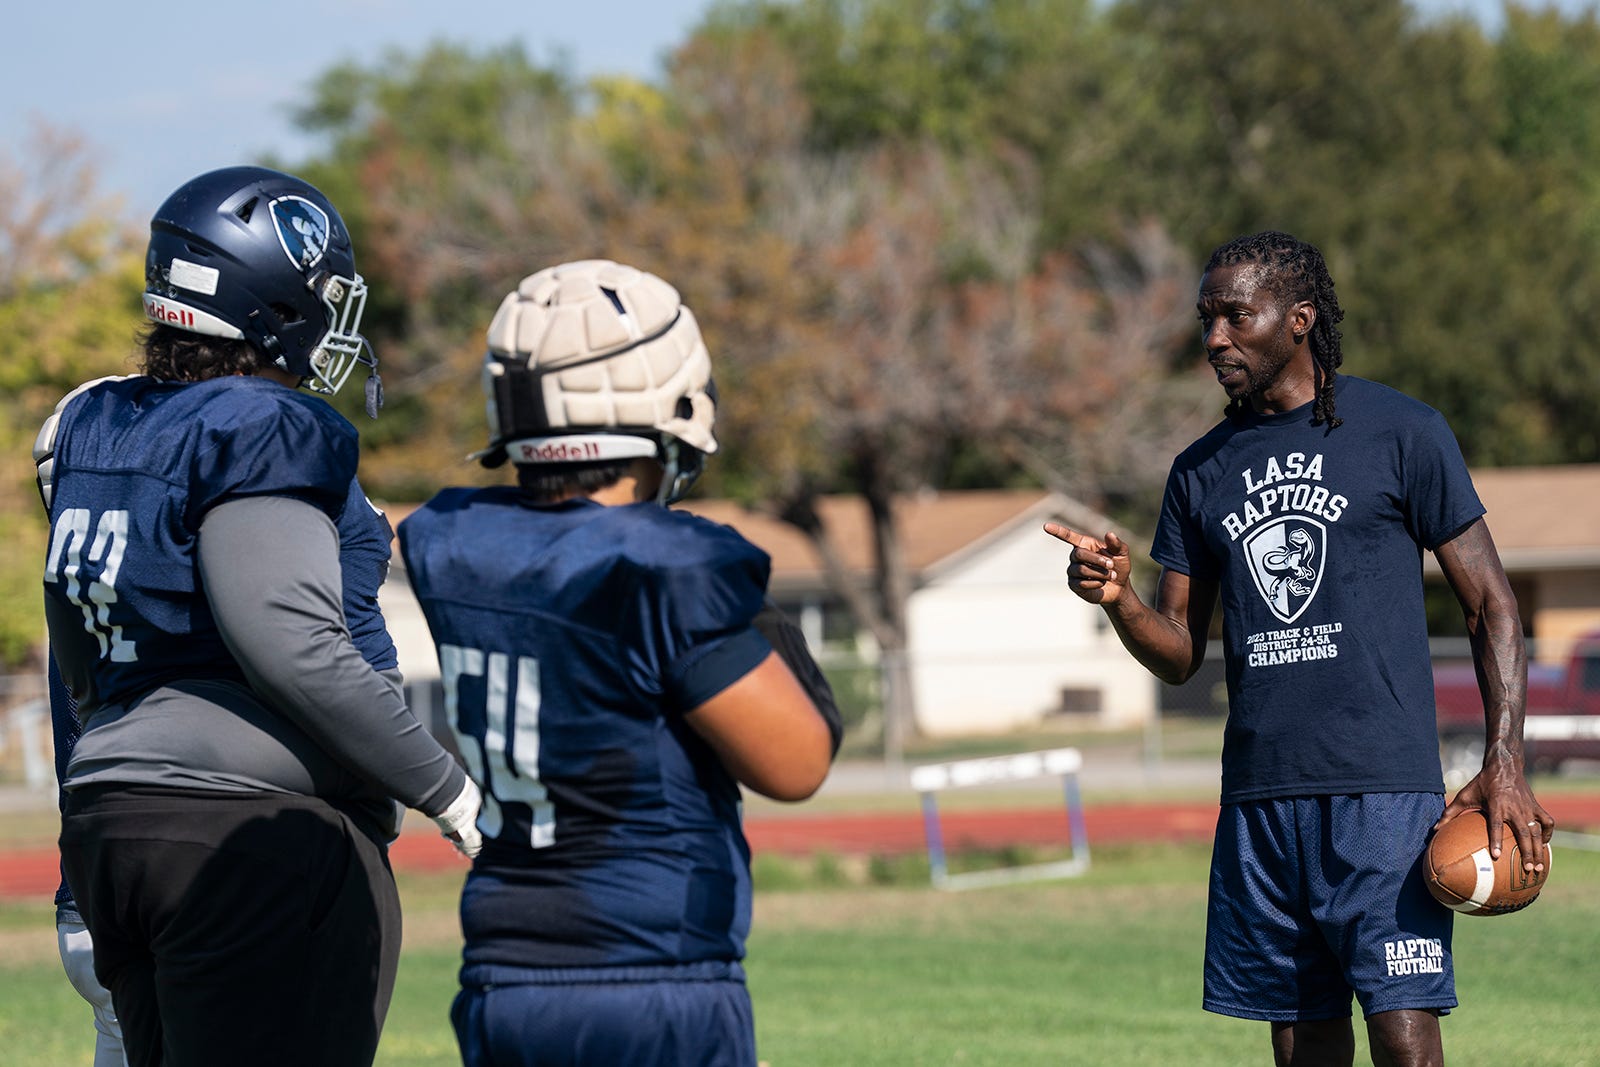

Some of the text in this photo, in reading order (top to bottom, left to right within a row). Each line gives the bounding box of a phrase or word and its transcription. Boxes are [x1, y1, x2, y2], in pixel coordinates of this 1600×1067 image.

[520, 442, 599, 461] Riddell
[1241, 452, 1324, 495] LASA
[1221, 483, 1349, 542] RAPTORS
[1246, 622, 1343, 645] 2023 TRACK & FIELD
[1253, 634, 1331, 653] DISTRICT 24-5A
[1248, 643, 1338, 668] CHAMPIONS
[440, 643, 556, 849] 54
[1384, 938, 1444, 961] RAPTOR
[1386, 957, 1443, 977] FOOTBALL
